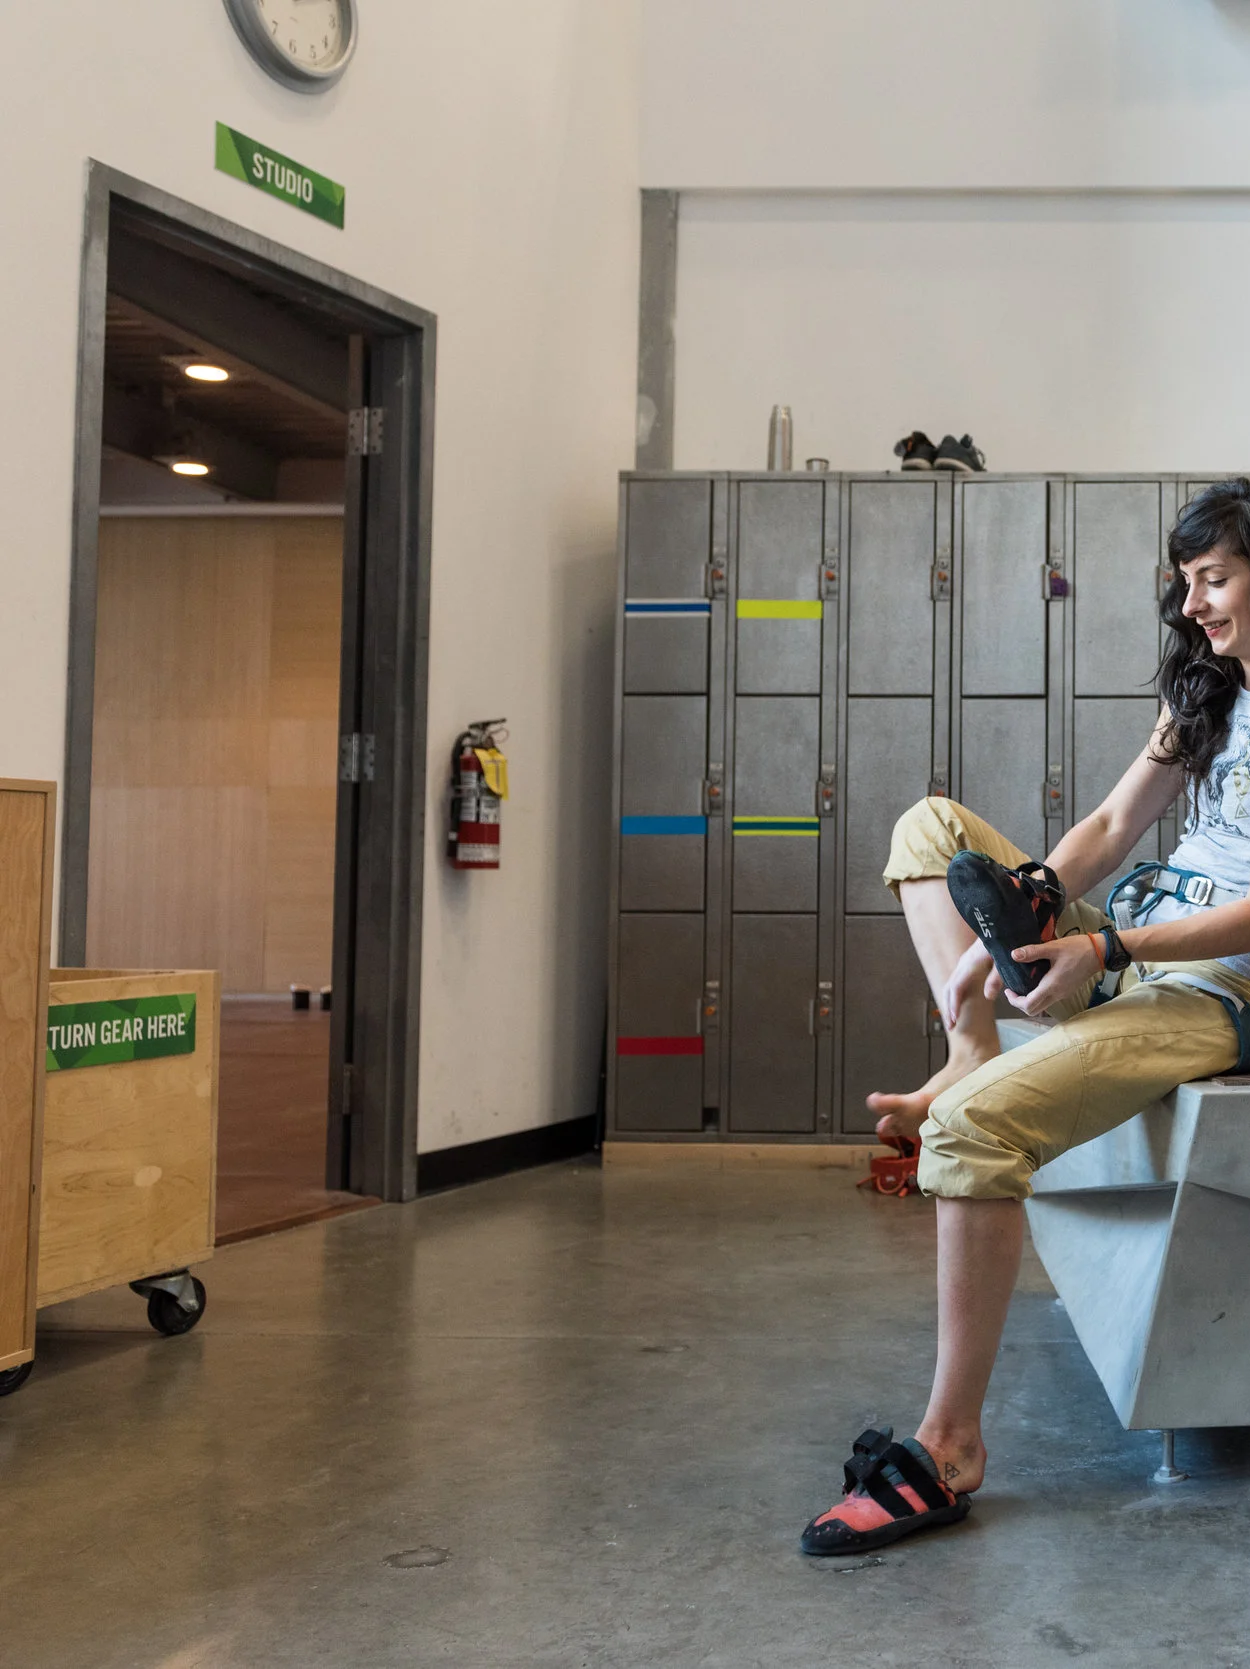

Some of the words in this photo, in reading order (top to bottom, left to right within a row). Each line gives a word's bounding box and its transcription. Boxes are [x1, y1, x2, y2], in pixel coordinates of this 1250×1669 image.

[272, 19, 279, 35] 7
[288, 38, 297, 54] 6
[252, 152, 313, 204] STUDIO
[48, 1022, 96, 1051] TURN
[100, 1016, 144, 1045] GEAR
[147, 1012, 187, 1040] HERE
